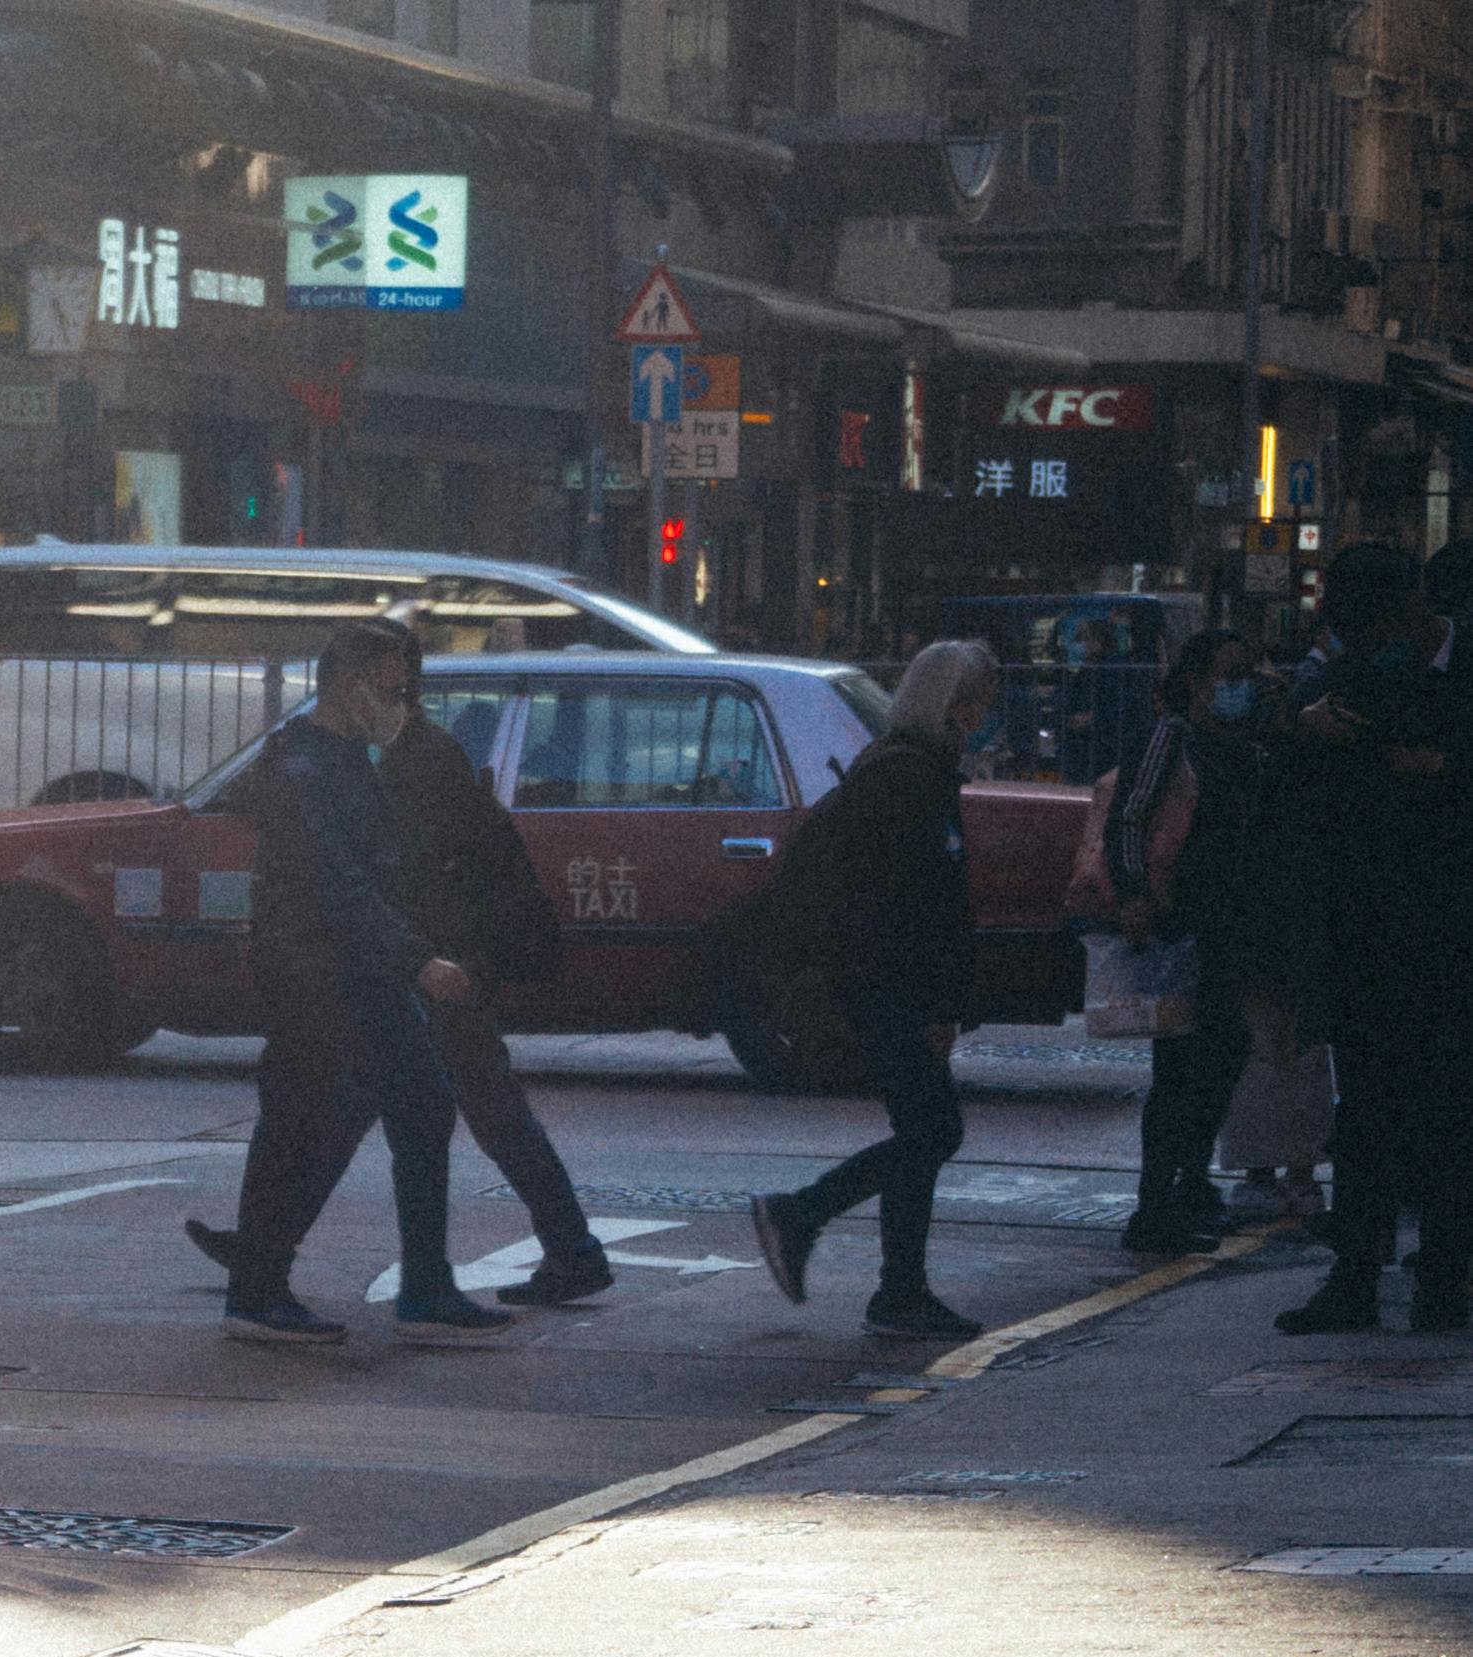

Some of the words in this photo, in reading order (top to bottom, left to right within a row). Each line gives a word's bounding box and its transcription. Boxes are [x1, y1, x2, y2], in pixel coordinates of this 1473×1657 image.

[377, 291, 444, 308] 24-hour
[1001, 389, 1121, 427] KFC
[974, 458, 1069, 498] 洋服
[566, 855, 639, 886] 的士
[566, 887, 639, 920] TAXI
